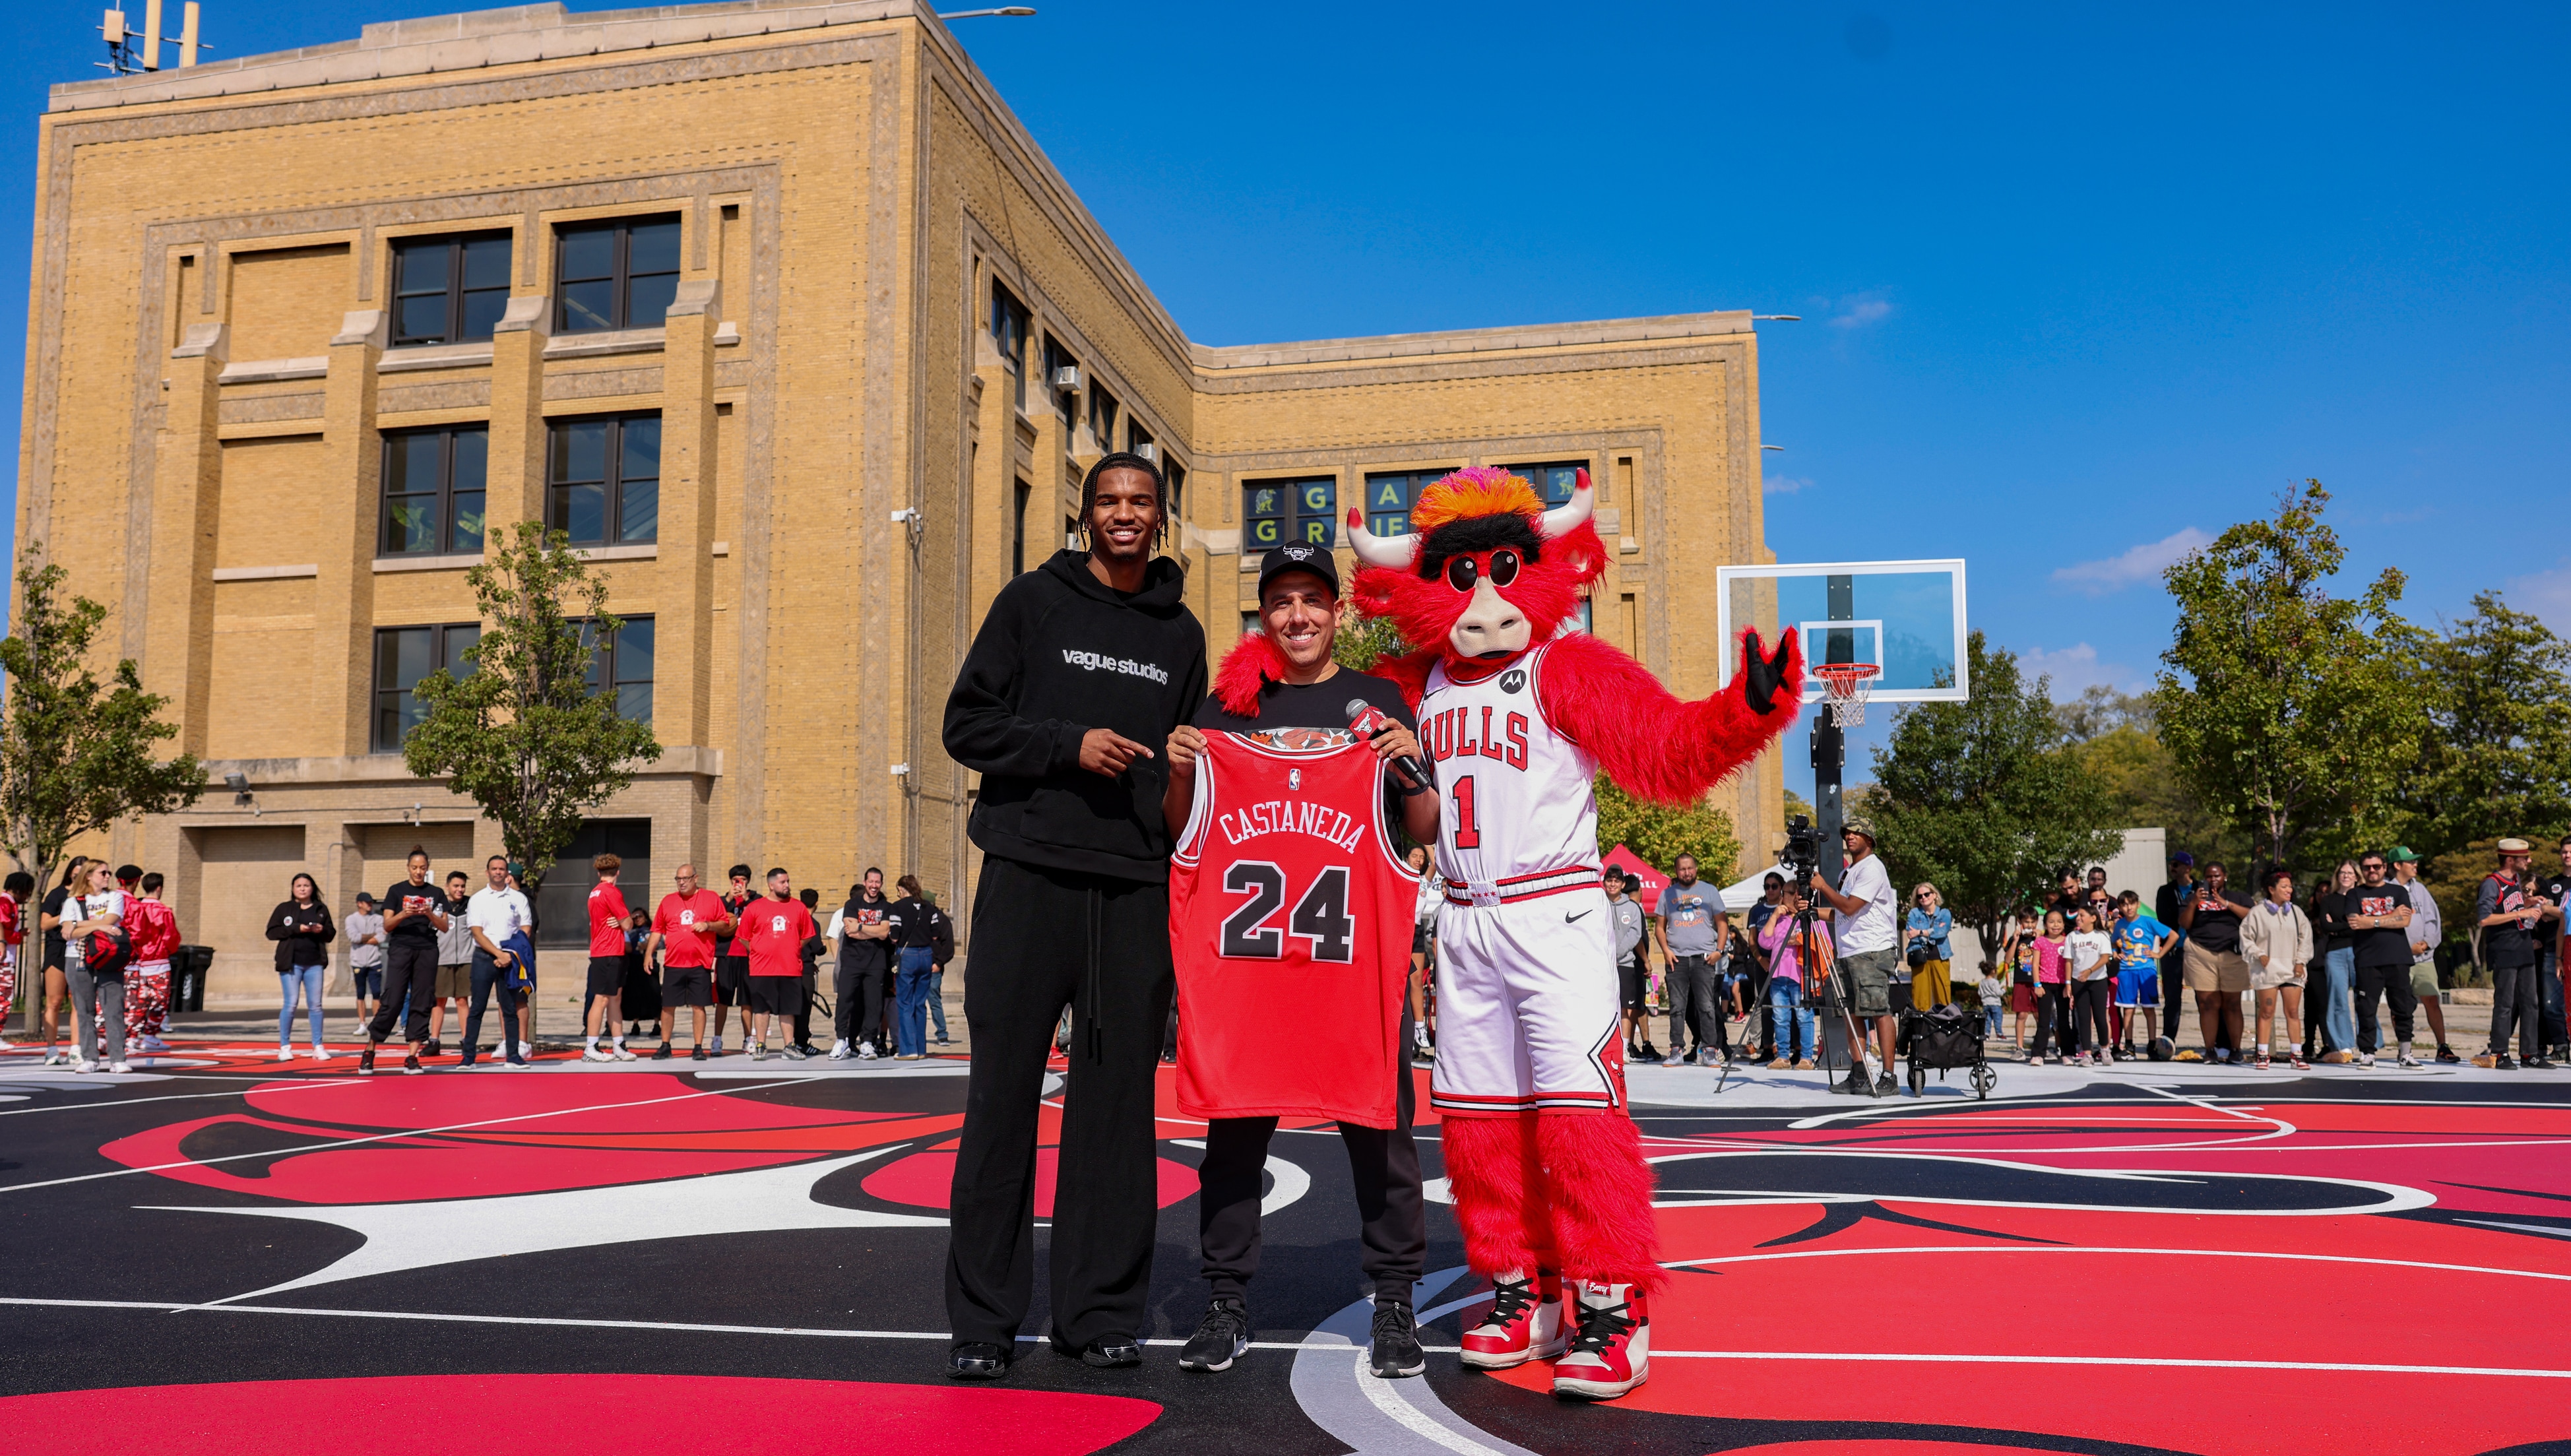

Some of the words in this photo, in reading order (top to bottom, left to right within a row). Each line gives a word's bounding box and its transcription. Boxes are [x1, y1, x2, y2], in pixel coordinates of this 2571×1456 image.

[1062, 649, 1117, 670] vague
[1117, 659, 1168, 685] studios
[1420, 706, 1528, 778] BULLS
[1219, 800, 1366, 854] CASTANEDA
[1453, 775, 1480, 850] 1
[1219, 860, 1355, 965] 24
[1674, 916, 1705, 928] CHICAGO
[1587, 1282, 1610, 1296] Benny
